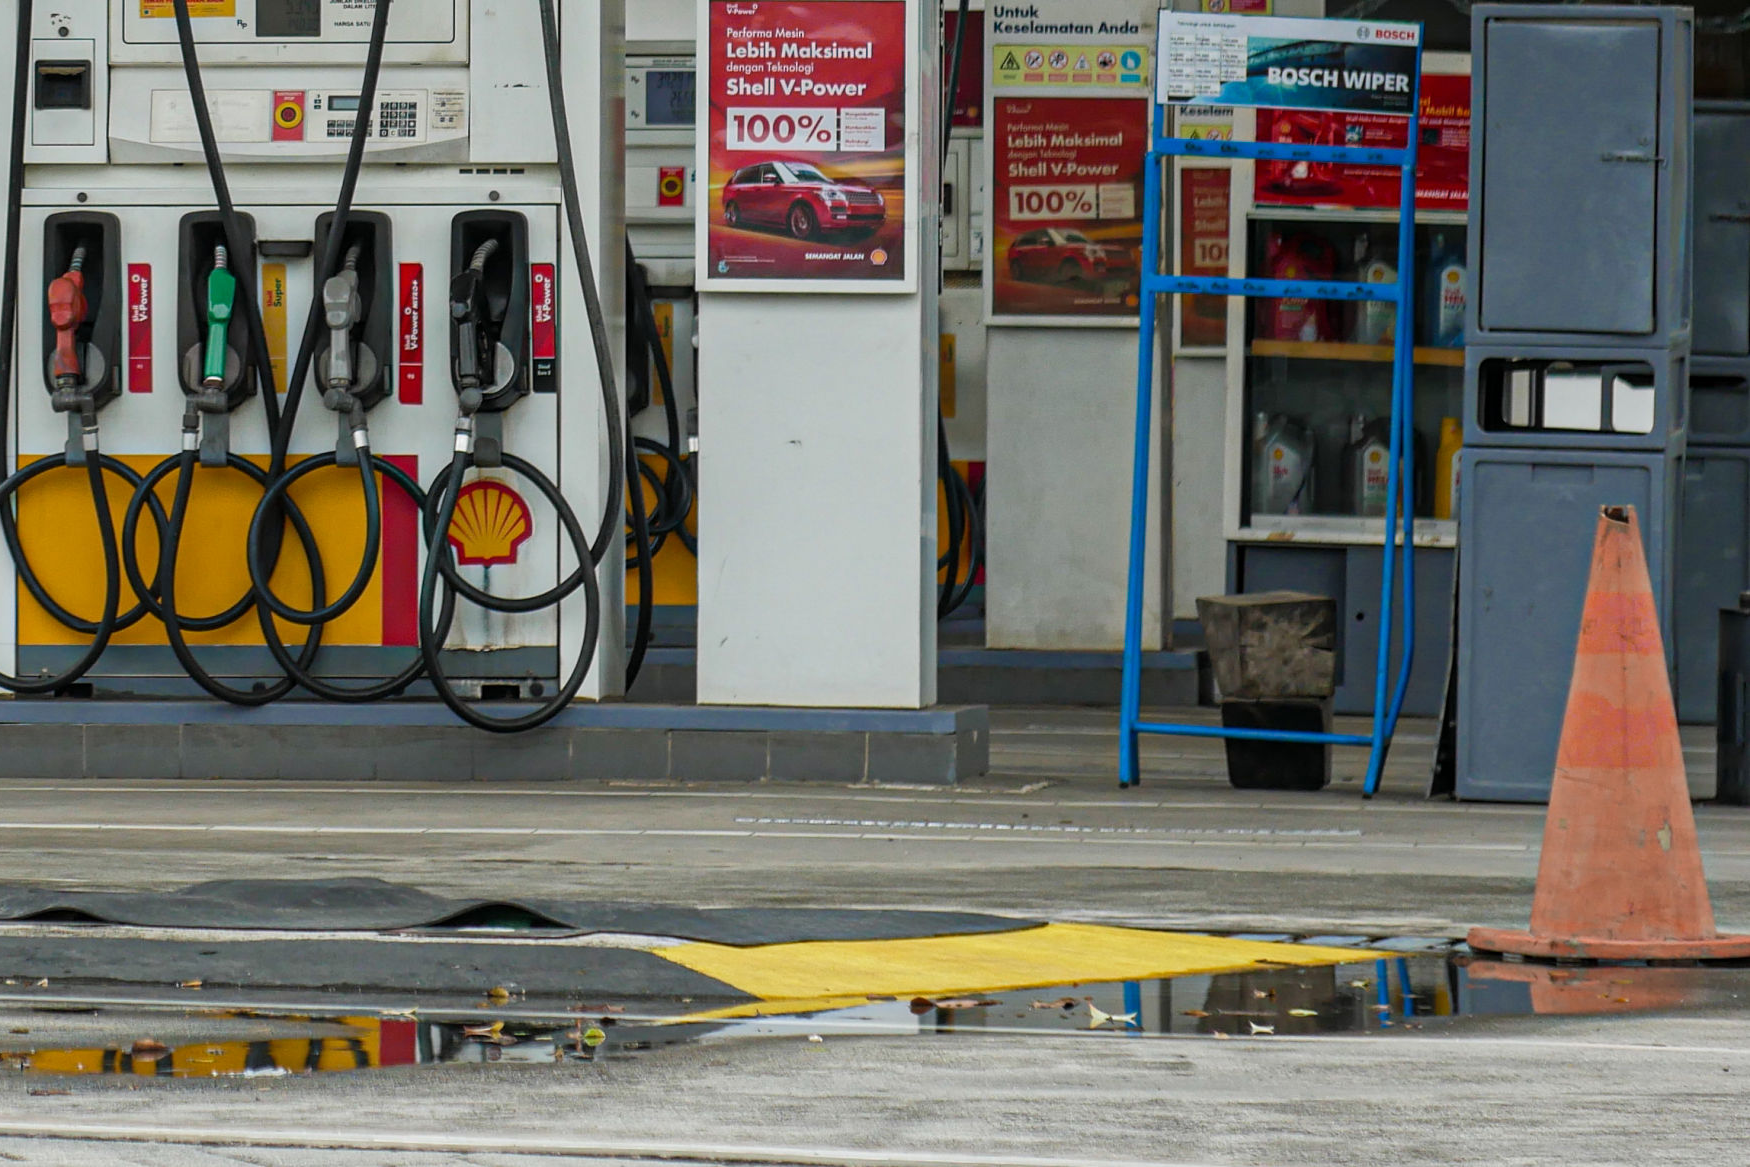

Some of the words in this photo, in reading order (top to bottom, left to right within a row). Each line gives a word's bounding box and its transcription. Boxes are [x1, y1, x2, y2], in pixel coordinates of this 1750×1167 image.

[993, 5, 1039, 18] Untuk
[726, 27, 772, 38] Performa
[775, 27, 805, 38] Mesin
[993, 21, 1094, 34] Keselamatan
[1098, 21, 1139, 34] Anda
[1375, 28, 1415, 40] BOSCH
[726, 42, 777, 59] Lebih
[781, 42, 873, 59] Maksimal
[726, 62, 764, 74] dengan
[766, 62, 814, 74] Teknologi
[726, 78, 775, 96] Shell
[780, 79, 866, 96] V-Power
[1267, 66, 1339, 89] BOSCH
[1344, 70, 1410, 93] WIPER
[733, 114, 832, 144] 100%
[1008, 134, 1046, 148] Lebih
[1051, 133, 1123, 148] Maksimal
[1008, 162, 1047, 178] Shell
[1051, 163, 1119, 178] V-Power
[1014, 190, 1092, 214] 100%
[139, 277, 149, 322] V-Power
[273, 278, 282, 307] Super
[543, 277, 551, 322] V-Power
